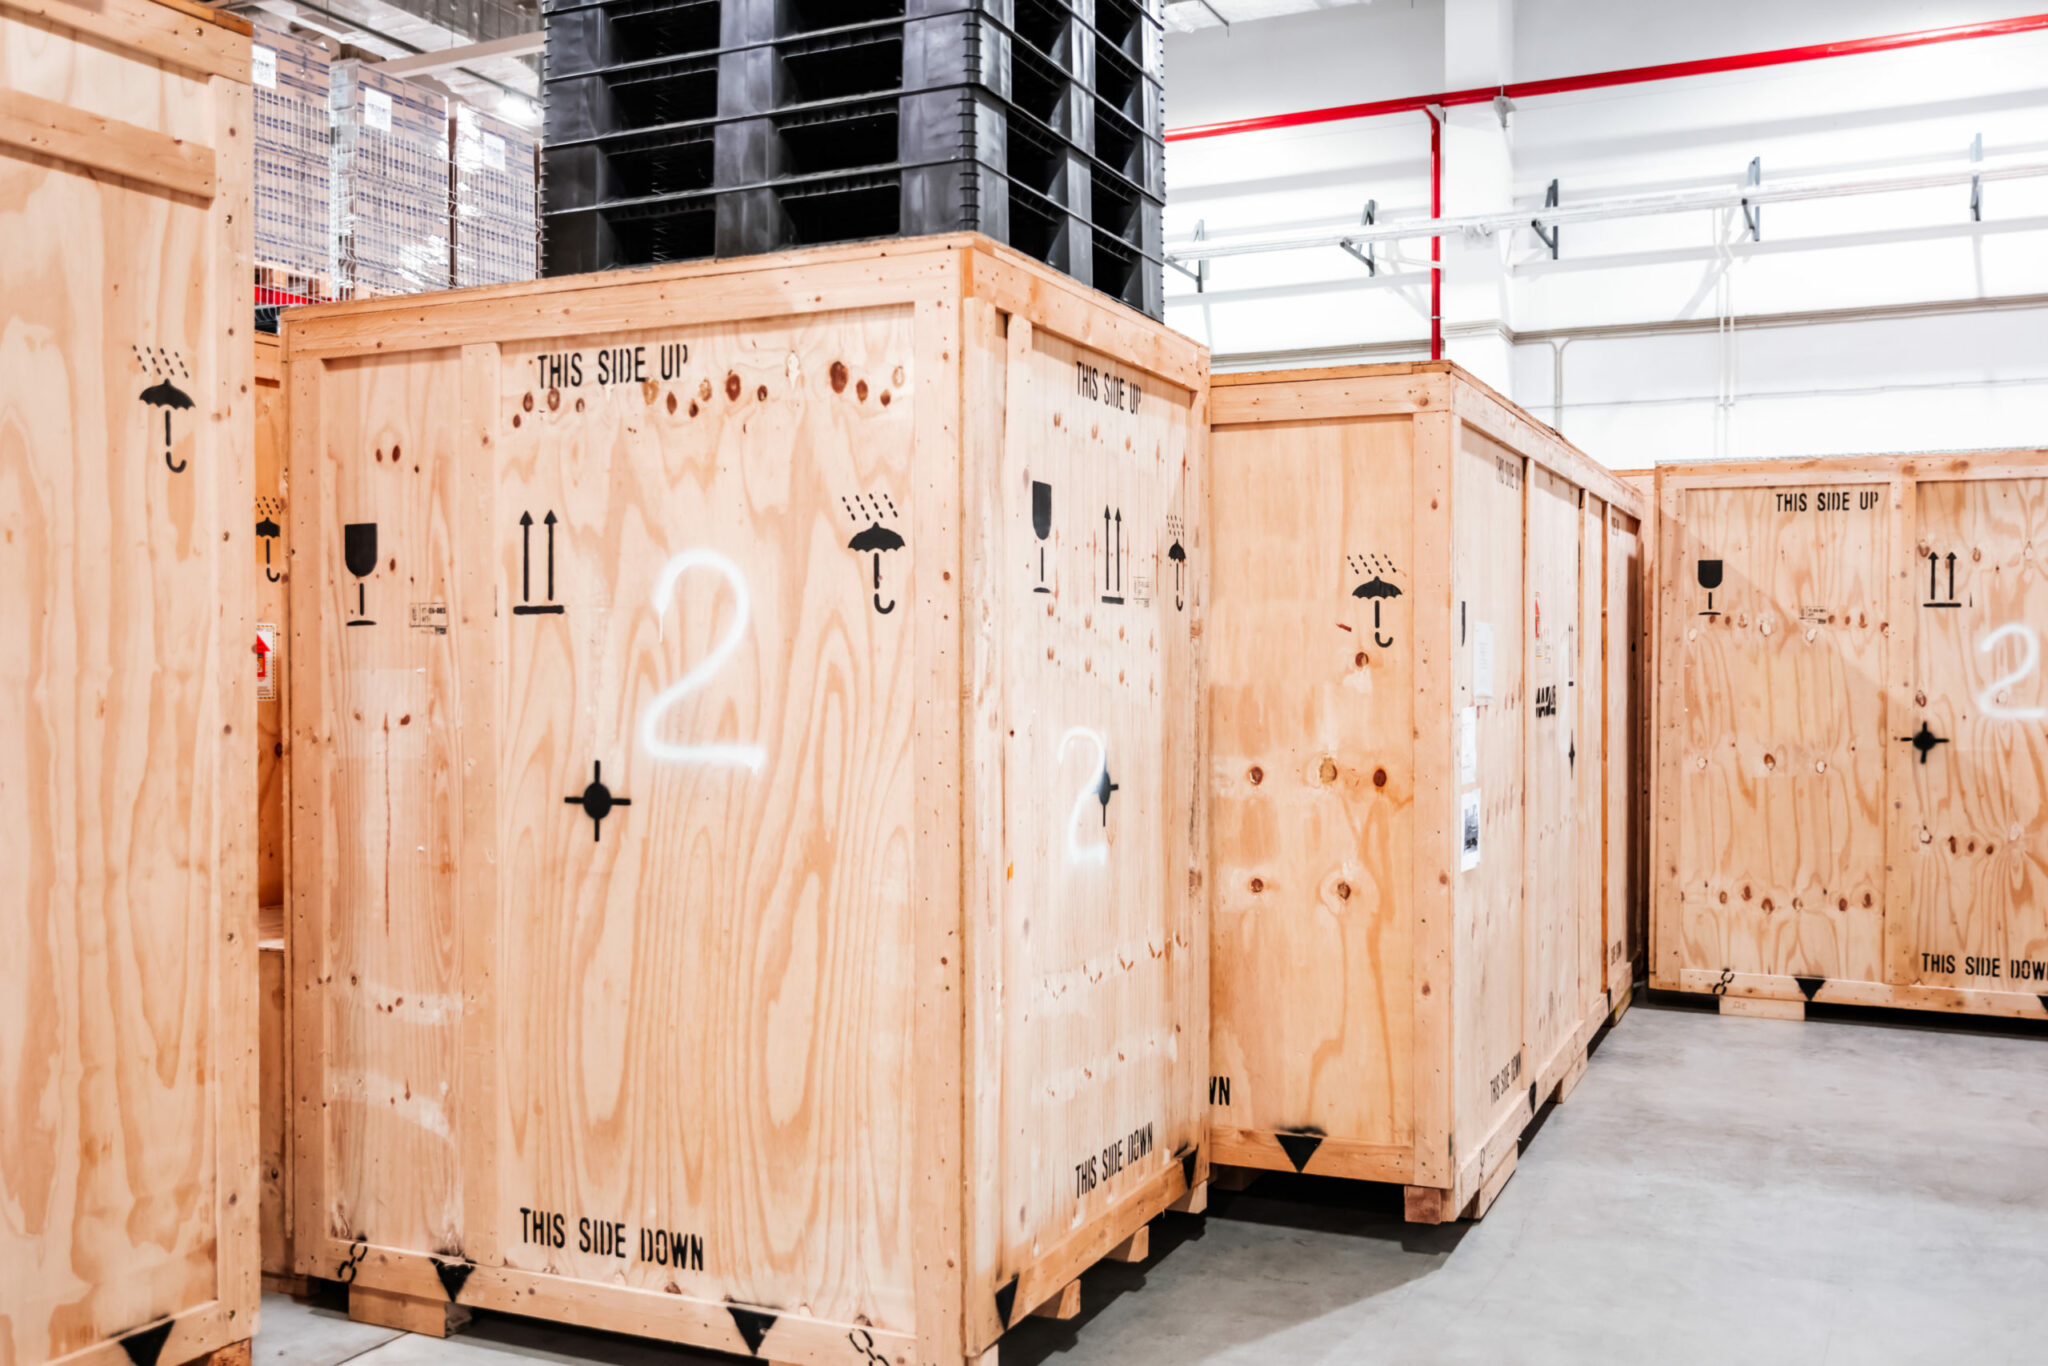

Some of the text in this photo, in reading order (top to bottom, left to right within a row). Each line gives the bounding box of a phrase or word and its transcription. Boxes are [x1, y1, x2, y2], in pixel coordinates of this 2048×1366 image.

[537, 344, 688, 389] THIS SIDE UP
[1076, 361, 1142, 415] THIS SIDE UP
[1776, 491, 1879, 512] THIS SIDE UP
[641, 547, 766, 774] 2
[1978, 623, 2046, 719] 2
[1057, 725, 1107, 866] 2
[1921, 953, 2048, 981] THIS SIDE DOW
[1075, 1121, 1153, 1199] THIS SIDE DOWN
[520, 1207, 704, 1271] THIS SIDE DOWN
